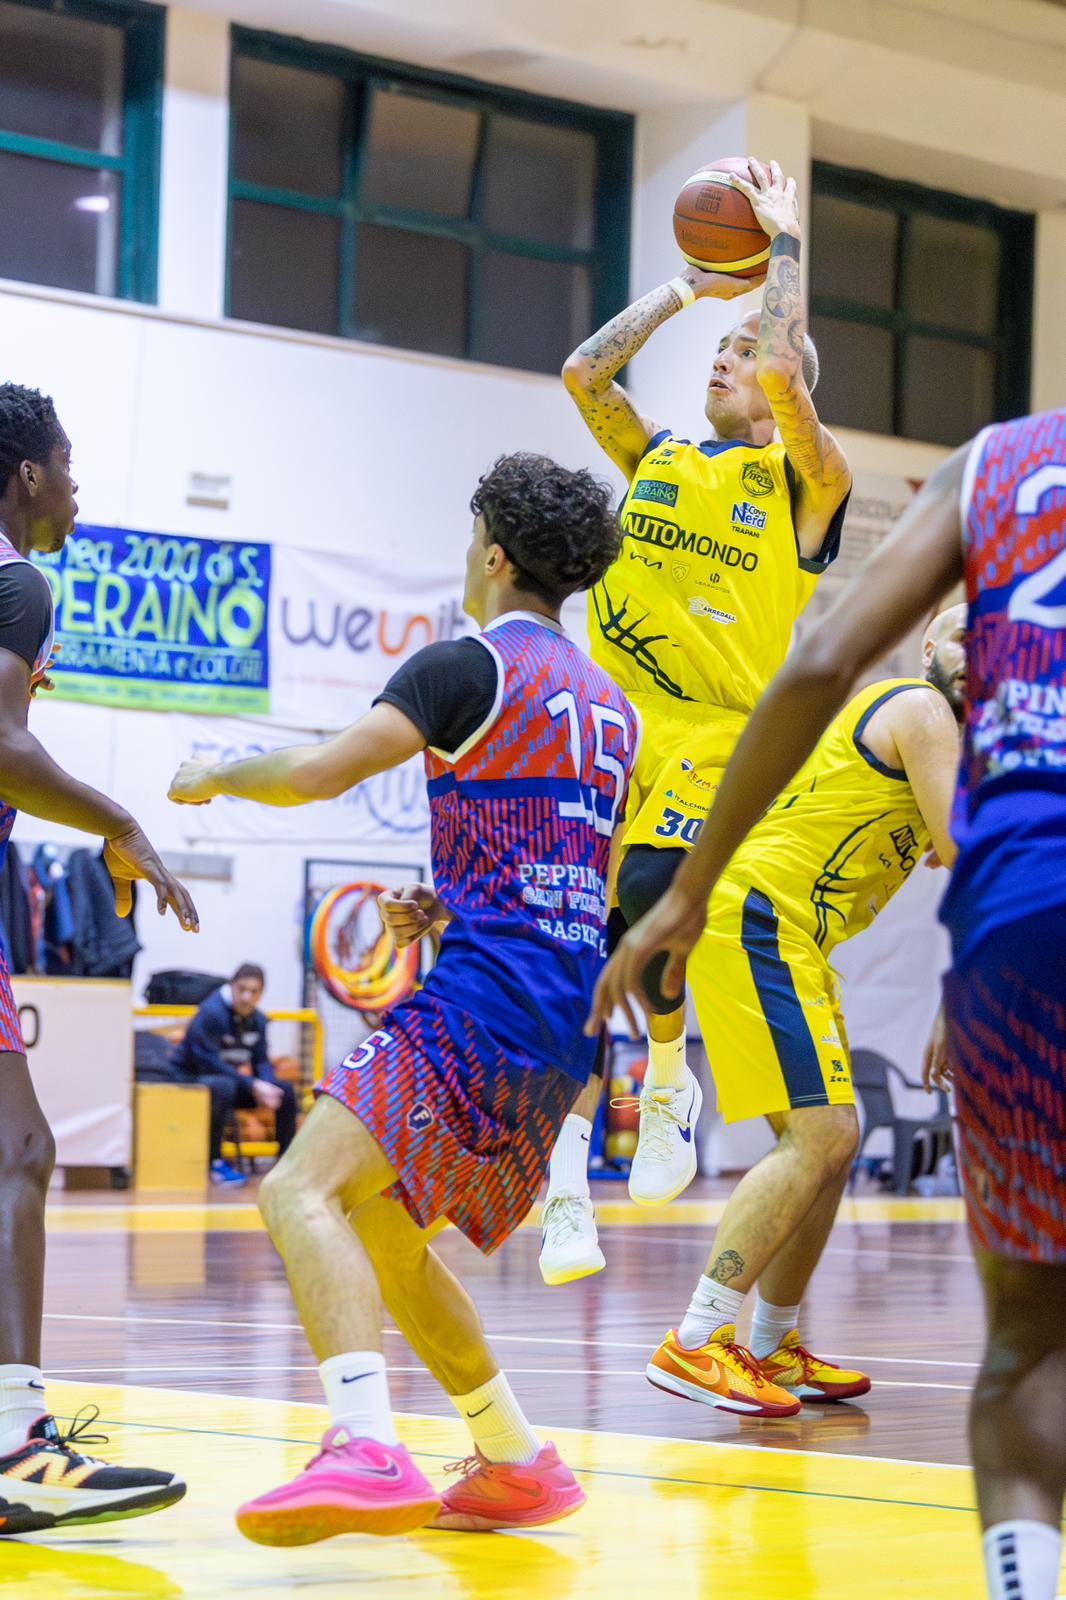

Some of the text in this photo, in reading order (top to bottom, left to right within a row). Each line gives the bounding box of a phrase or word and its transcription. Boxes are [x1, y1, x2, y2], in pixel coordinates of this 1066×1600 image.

[731, 502, 766, 528] Nerd
[117, 535, 200, 584] 2000
[622, 512, 759, 572] AUTOMONDO
[545, 688, 630, 837] 15
[655, 806, 704, 845] 30
[341, 1029, 394, 1070] 5
